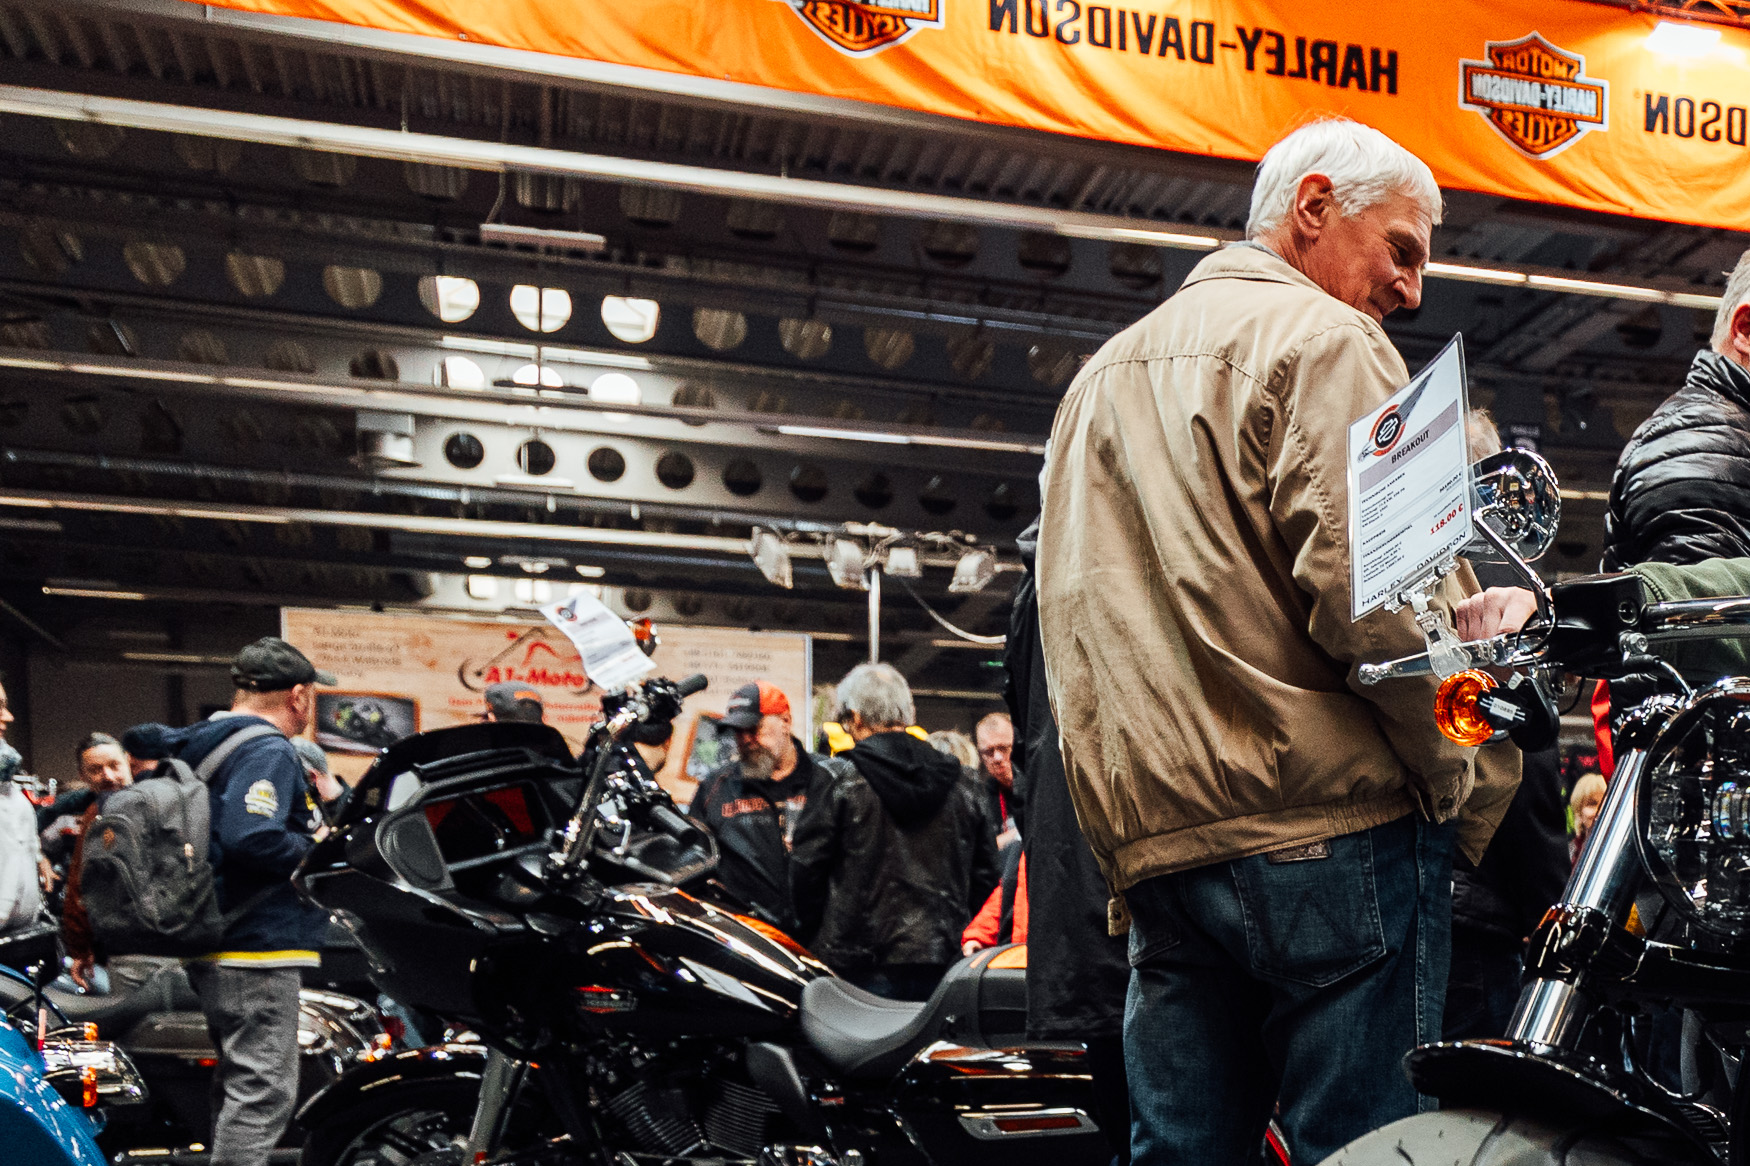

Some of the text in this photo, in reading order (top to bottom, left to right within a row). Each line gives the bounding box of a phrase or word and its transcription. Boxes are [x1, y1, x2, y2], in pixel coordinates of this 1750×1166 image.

[1391, 429, 1430, 464] BREAKOUT
[1430, 508, 1457, 535] 118.00
[485, 666, 585, 687] A1-Moto
